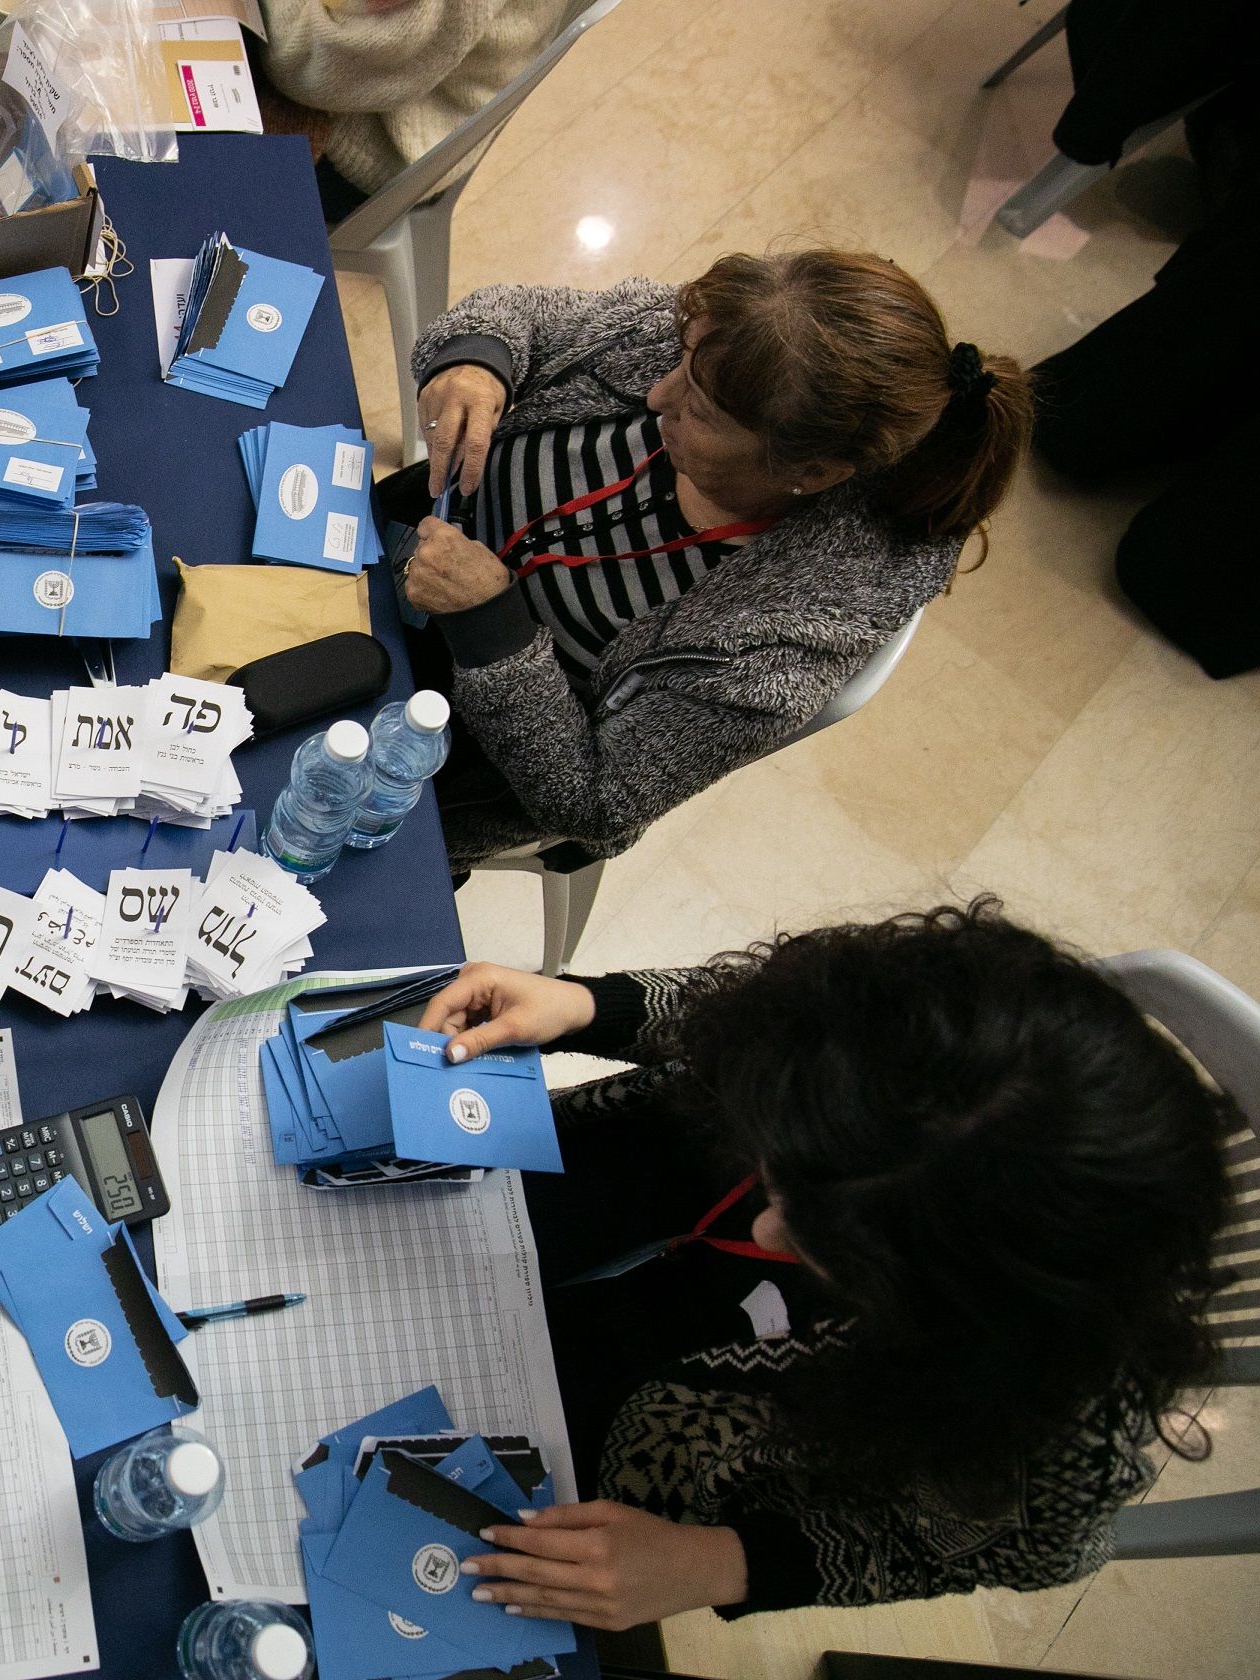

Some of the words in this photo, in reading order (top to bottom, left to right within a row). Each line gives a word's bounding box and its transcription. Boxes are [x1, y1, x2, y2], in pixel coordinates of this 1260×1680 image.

[163, 693, 221, 734] פה
[2, 710, 27, 749] ל
[71, 714, 134, 750] אמת
[120, 885, 179, 922] שס
[199, 906, 256, 979] מחל
[121, 1104, 132, 1128] CASIO
[41, 1126, 52, 1142] MRC
[14, 1163, 22, 1171] 4
[31, 1158, 40, 1167] 7
[2, 1188, 11, 1197] 2
[20, 1184, 29, 1192] 5
[37, 1179, 46, 1187] 8
[72, 1209, 93, 1236] ושלוש
